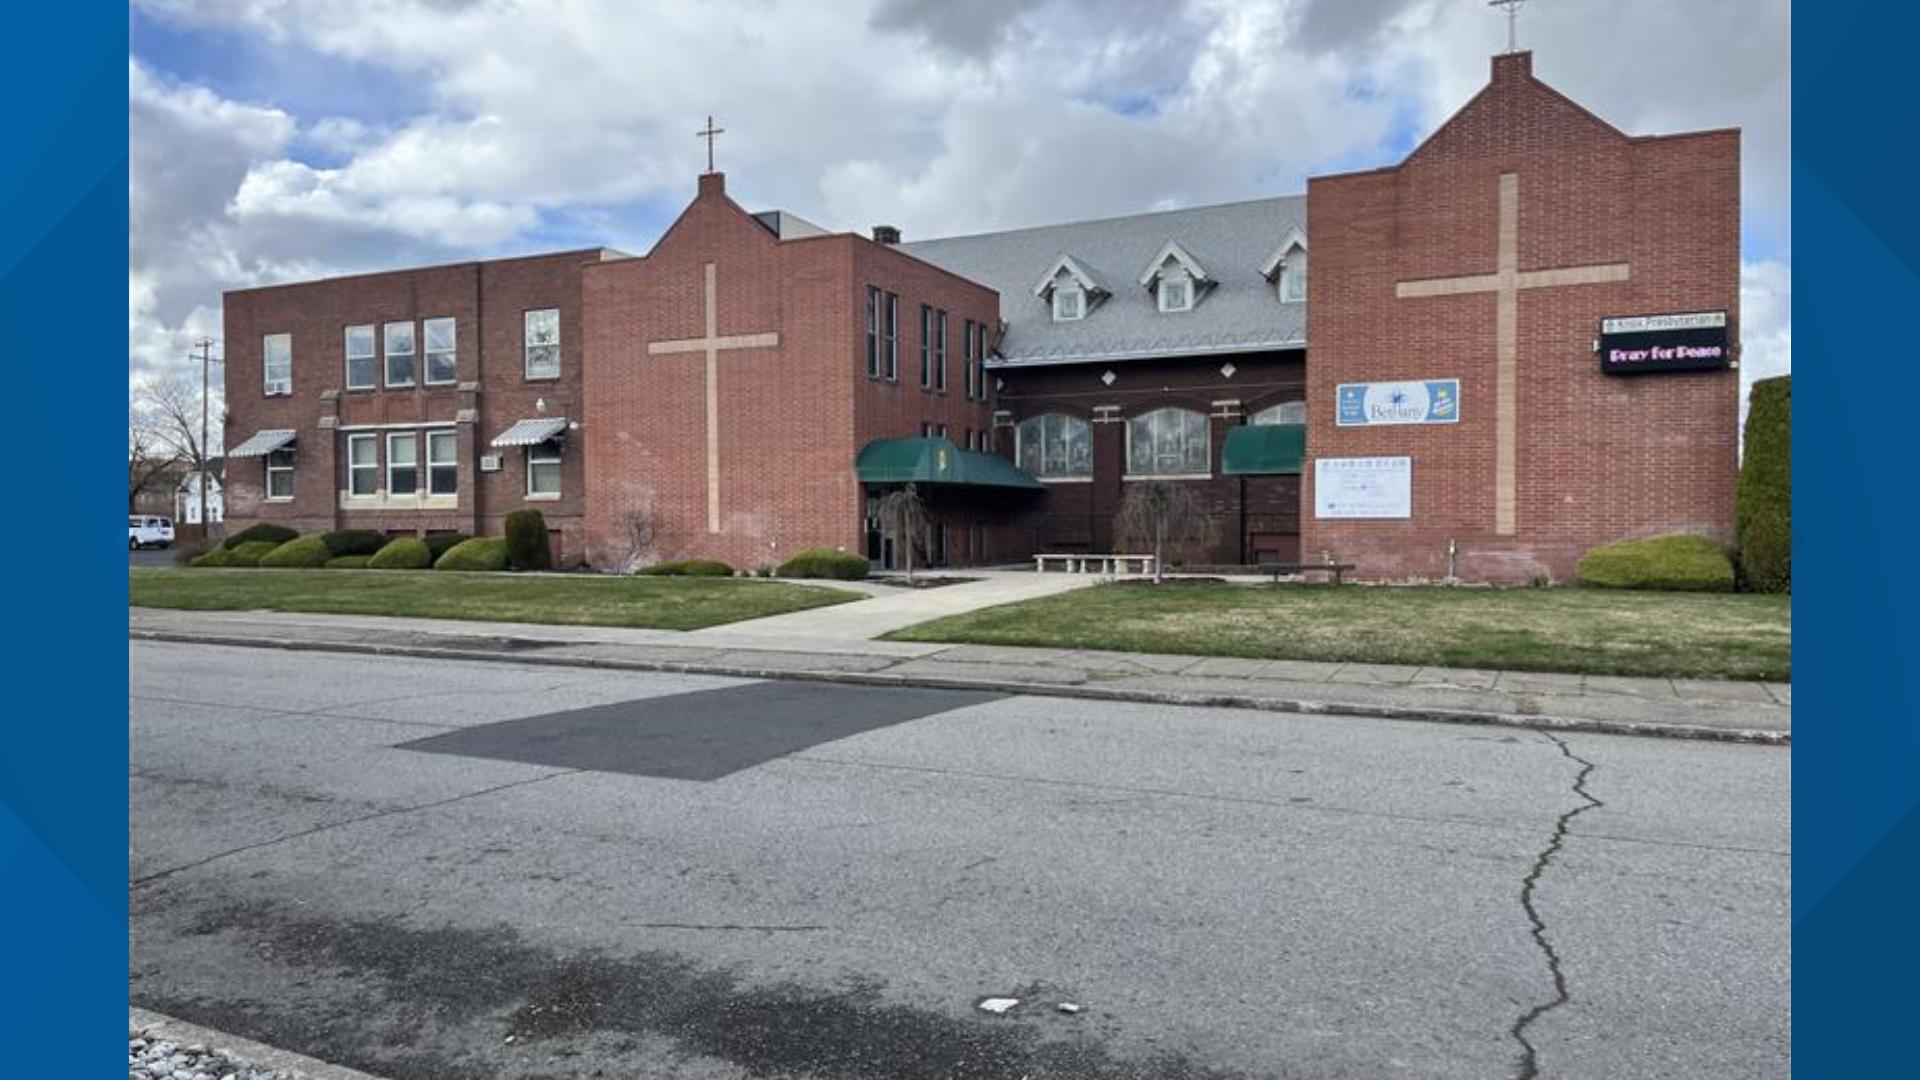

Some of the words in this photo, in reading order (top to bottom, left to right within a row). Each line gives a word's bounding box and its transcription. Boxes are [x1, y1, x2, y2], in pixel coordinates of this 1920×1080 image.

[1618, 318, 1643, 328] Knox
[1646, 314, 1713, 329] Presbyterian
[1610, 349, 1648, 362] Pray
[1651, 346, 1675, 360] for
[1676, 345, 1721, 358] Peace
[1371, 402, 1424, 420] Bethany
